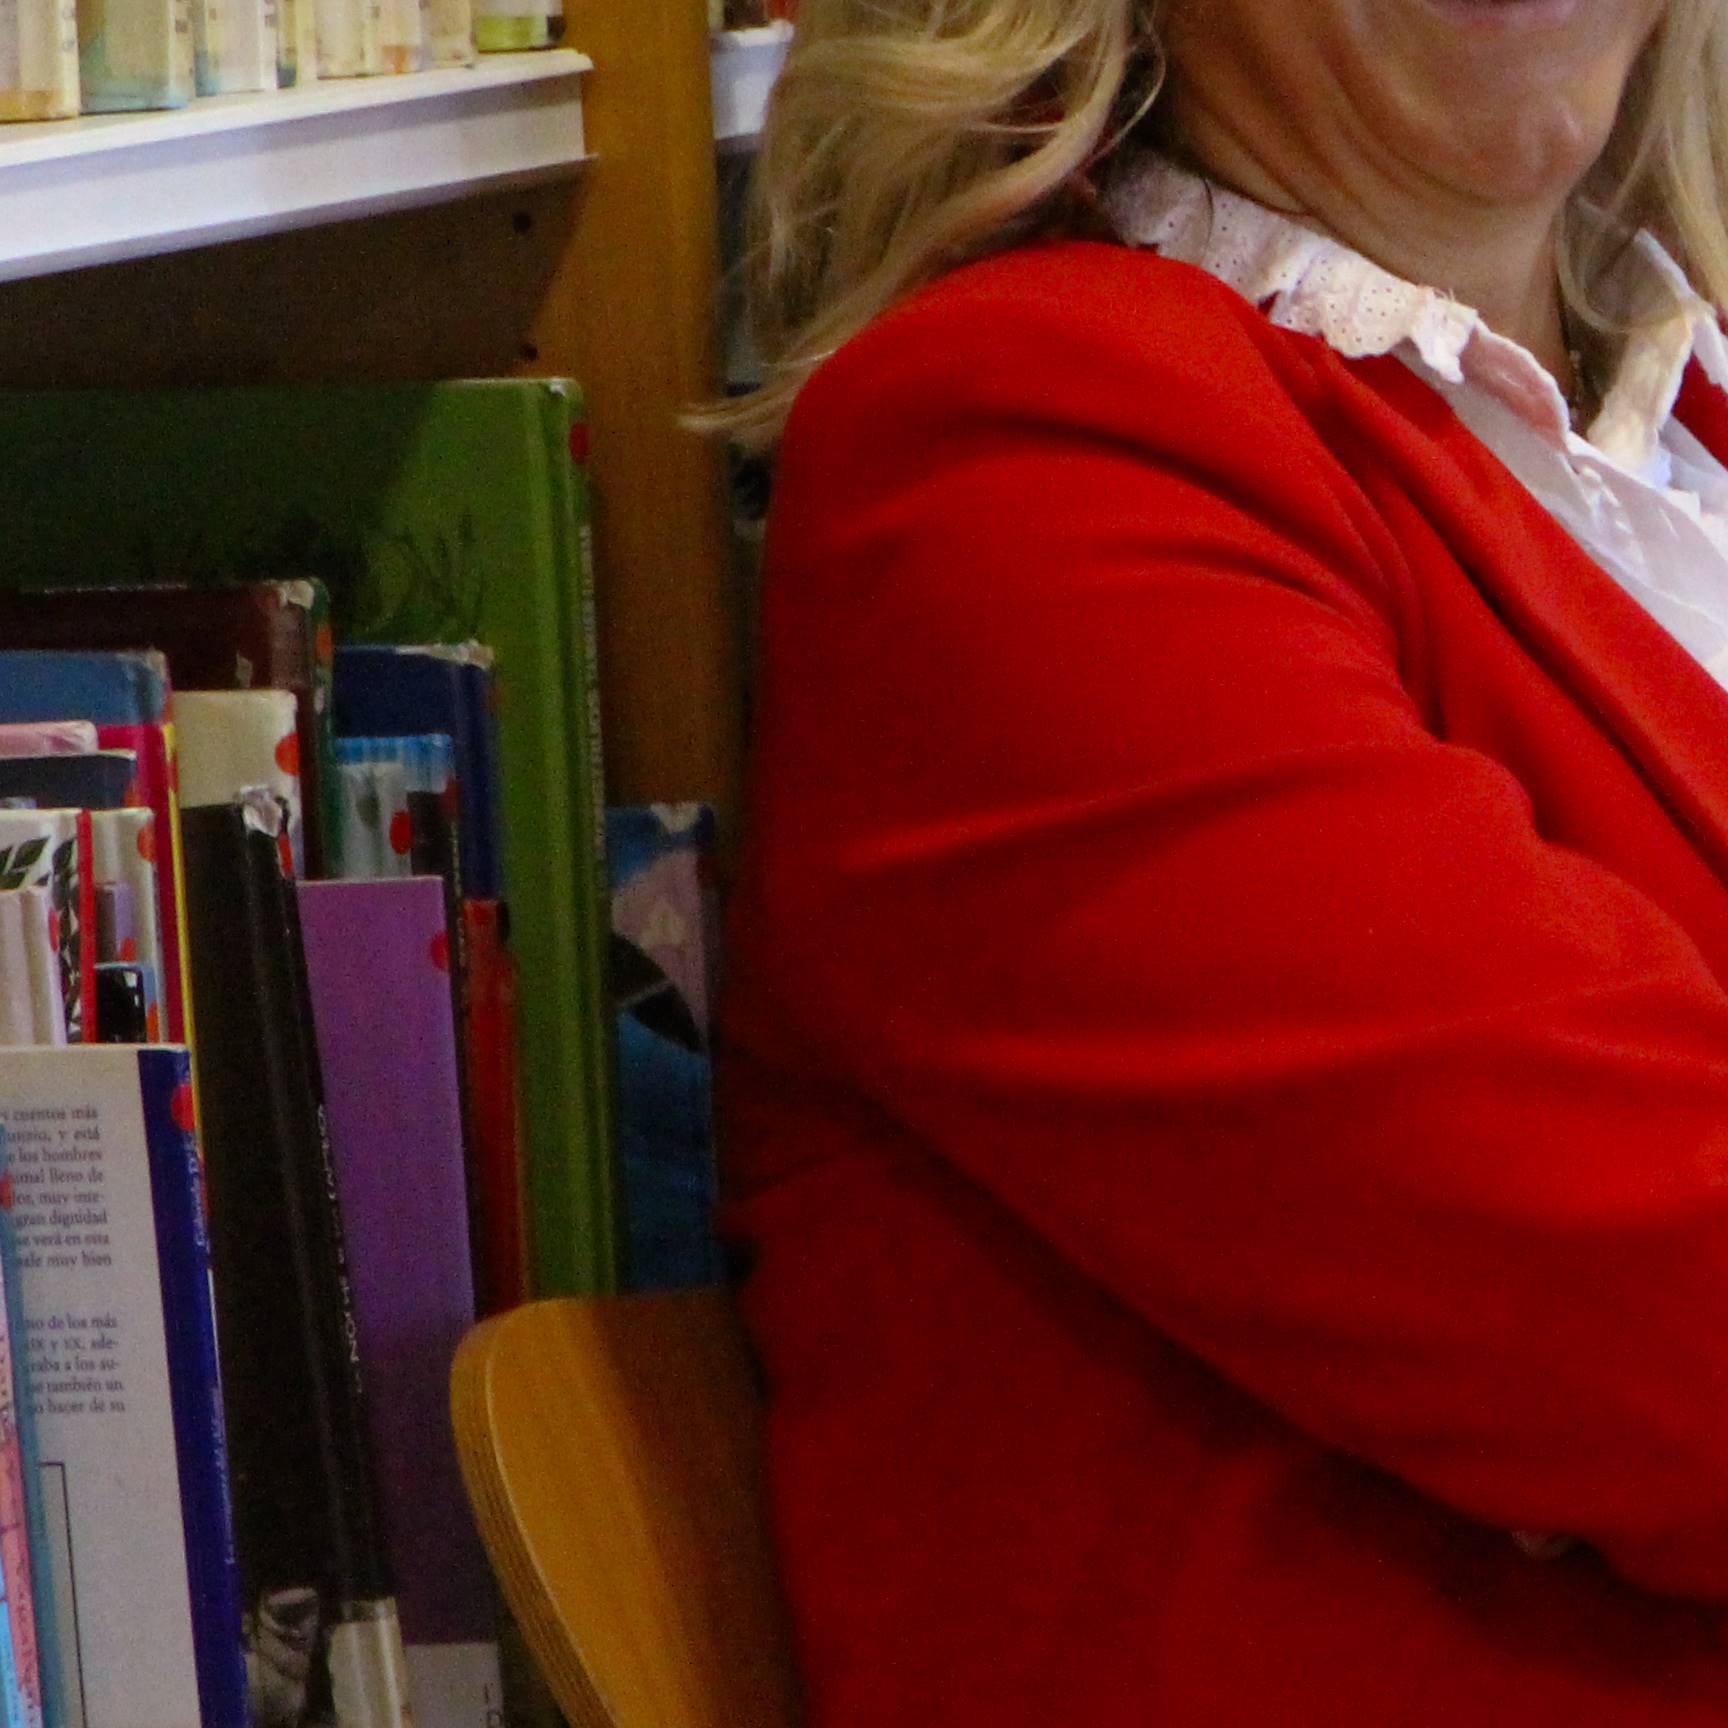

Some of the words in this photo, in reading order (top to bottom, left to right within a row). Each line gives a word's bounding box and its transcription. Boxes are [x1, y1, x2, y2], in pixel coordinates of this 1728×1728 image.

[13, 1108, 66, 1122] cuentos
[71, 1103, 98, 1121] más
[74, 1124, 100, 1141] está
[19, 1147, 39, 1163] los
[42, 1146, 102, 1163] hombres
[49, 1166, 84, 1184] lleno
[88, 1165, 104, 1184] de
[40, 1192, 68, 1206] muy
[48, 1208, 107, 1229] dignidad
[65, 1236, 81, 1248] en
[47, 1255, 78, 1271] muy
[81, 1250, 112, 1267] bien
[48, 1315, 65, 1330] de
[66, 1312, 88, 1329] los
[91, 1311, 118, 1329] más
[75, 1354, 95, 1370] los
[47, 1375, 102, 1391] también
[105, 1379, 124, 1390] un
[48, 1398, 84, 1413] hacer
[89, 1396, 105, 1411] de
[110, 1401, 125, 1411] su
